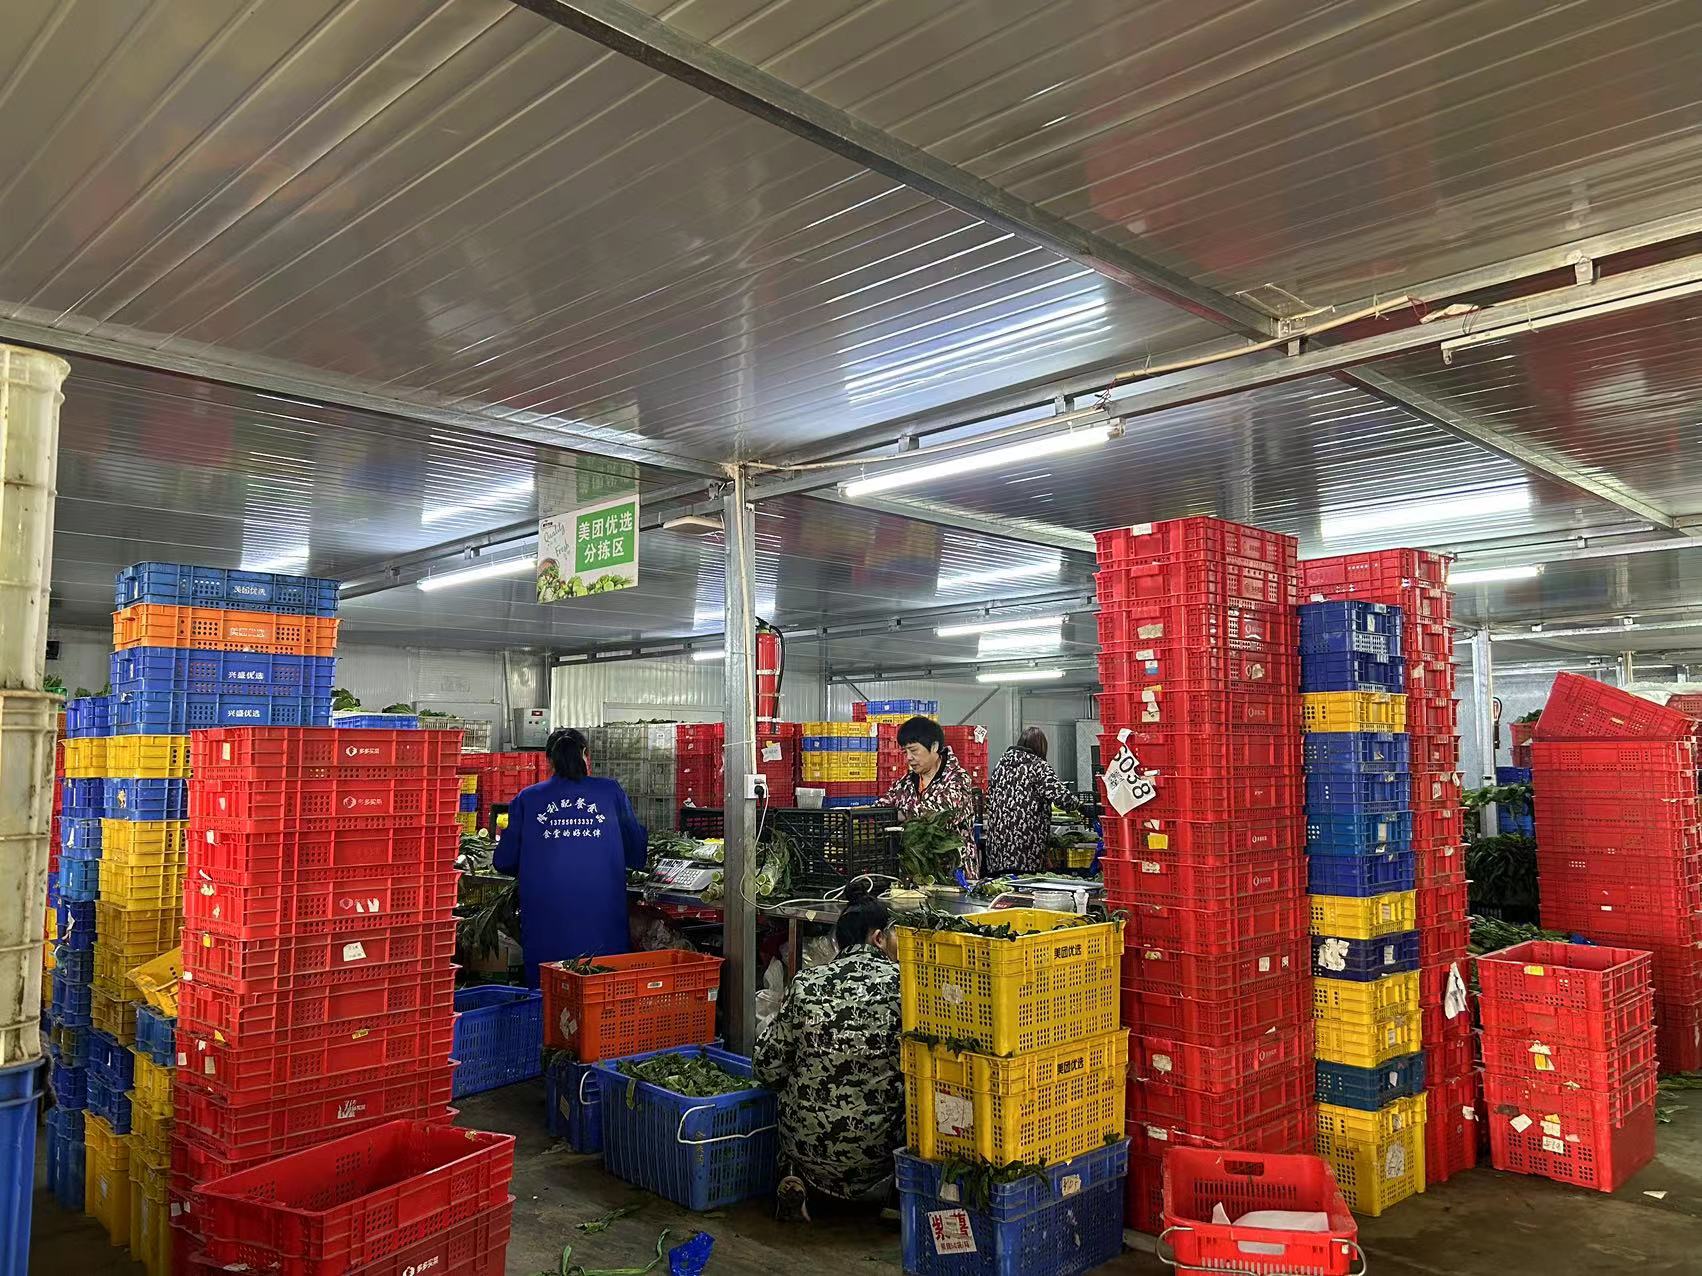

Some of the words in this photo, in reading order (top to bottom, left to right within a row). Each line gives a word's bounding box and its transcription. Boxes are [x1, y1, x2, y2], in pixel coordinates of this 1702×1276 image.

[578, 511, 633, 543] 美团优选
[584, 537, 625, 564] 分拣区
[228, 670, 265, 680] 兴盛优选
[227, 709, 261, 718] 兴盛优选
[549, 818, 594, 826] 13755013337
[542, 828, 602, 839] 食堂的好伙伴
[1054, 944, 1082, 960] 美团优选
[1057, 1057, 1085, 1076] 美团优选
